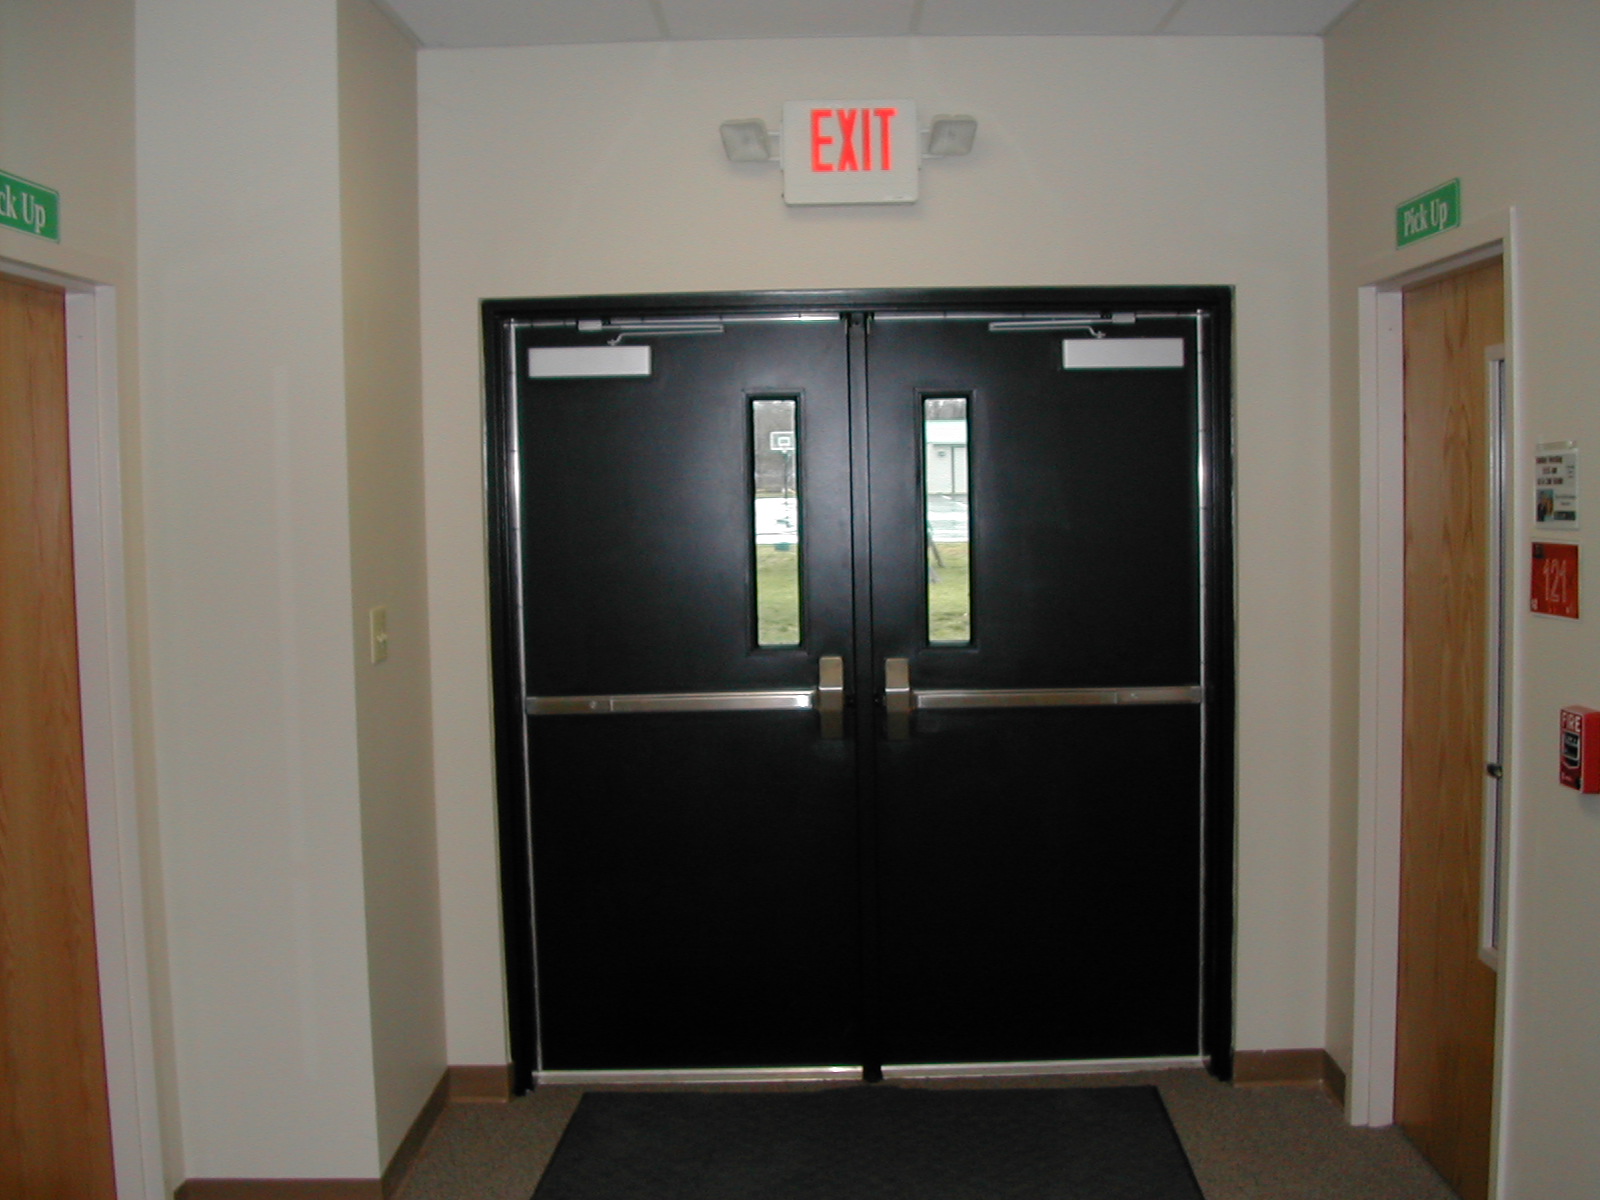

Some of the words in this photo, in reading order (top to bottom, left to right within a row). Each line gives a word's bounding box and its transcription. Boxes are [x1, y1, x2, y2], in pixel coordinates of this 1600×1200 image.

[810, 107, 899, 172] EXIT
[22, 193, 46, 233] Up
[1403, 203, 1429, 237] Pick
[1430, 199, 1448, 230] Up
[1543, 558, 1567, 603] 121
[1561, 711, 1581, 732] FIRE
